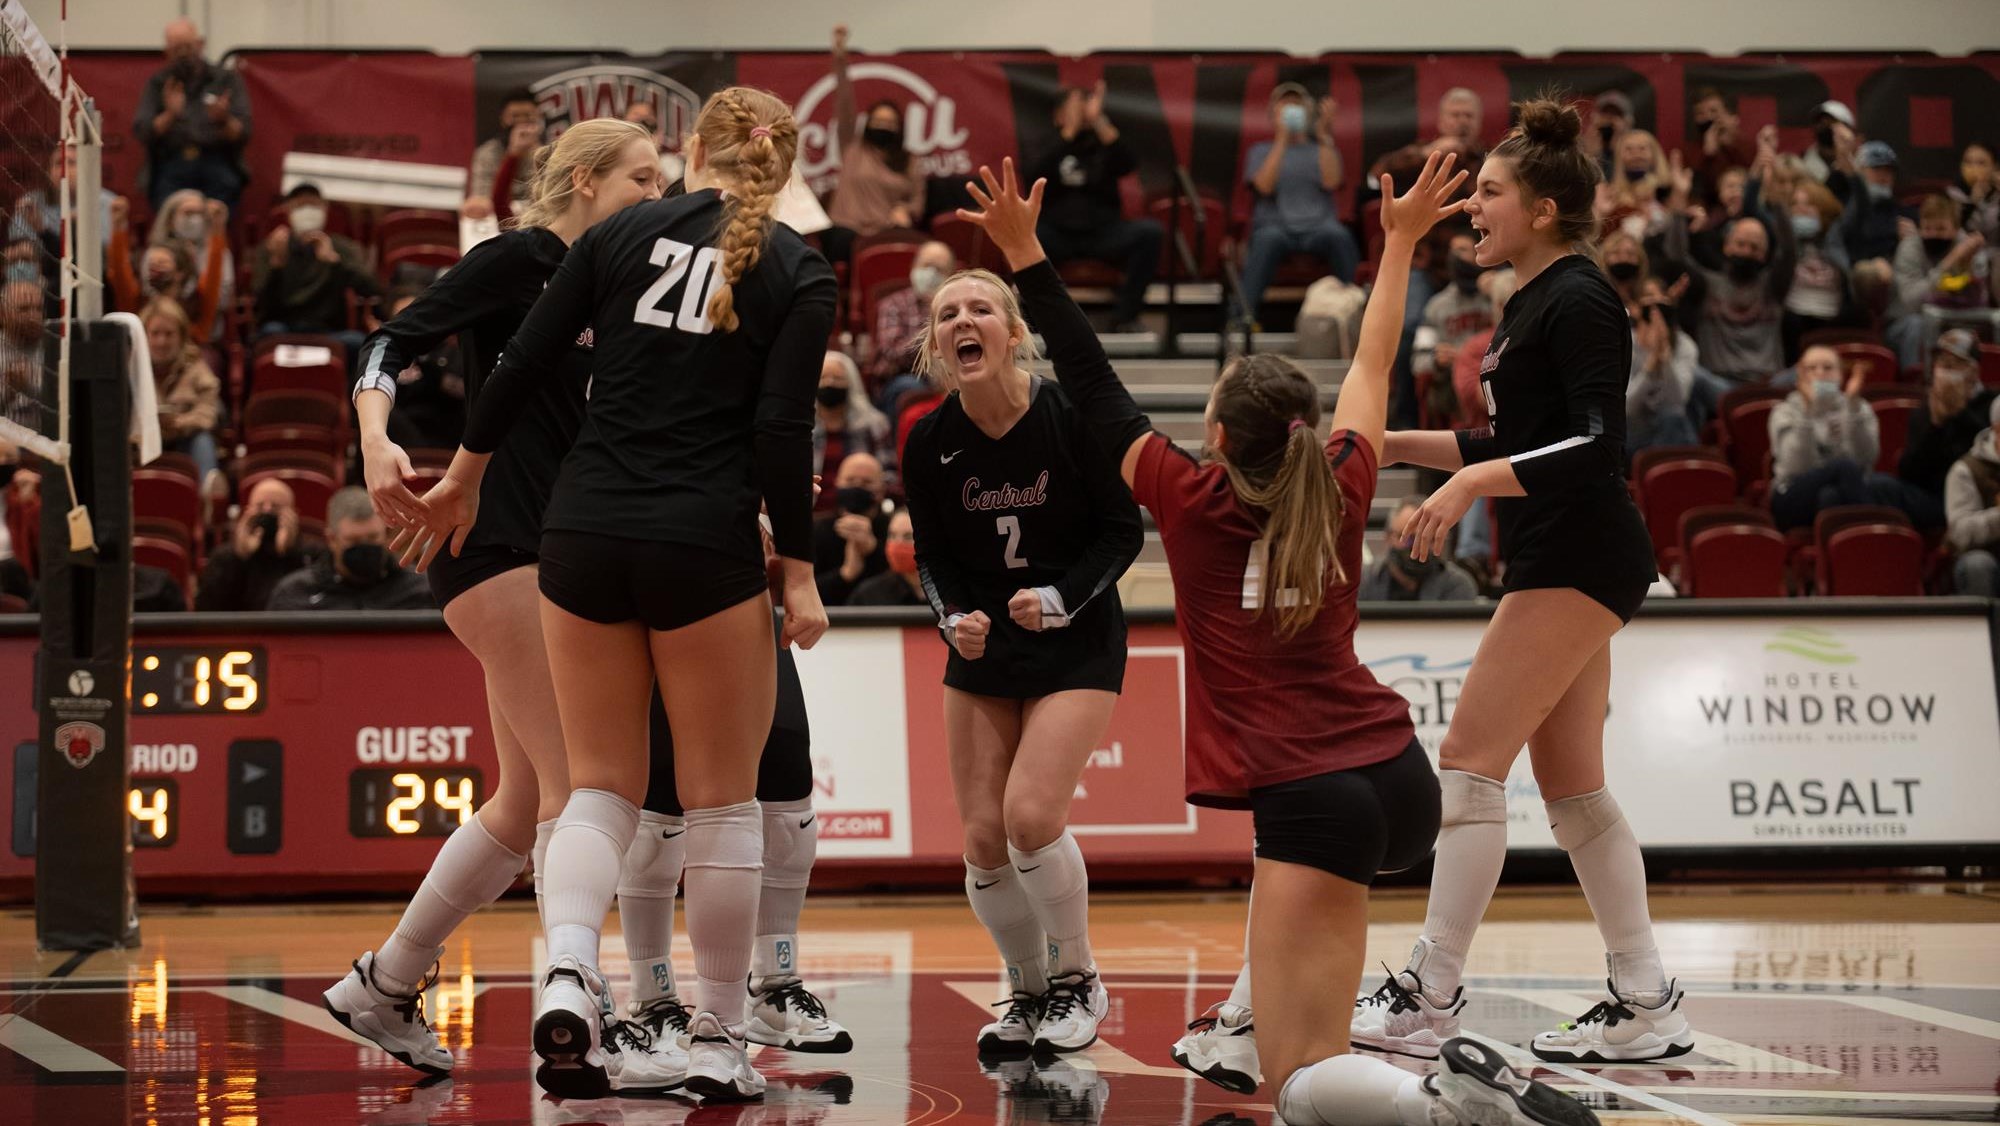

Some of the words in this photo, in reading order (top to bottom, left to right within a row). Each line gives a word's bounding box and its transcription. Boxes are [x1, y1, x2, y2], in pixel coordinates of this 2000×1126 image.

[633, 237, 728, 335] 20
[962, 470, 1048, 511] Central
[996, 515, 1029, 569] 2
[1764, 672, 1860, 689] HOTEL
[1698, 694, 1936, 725] WINDROW
[131, 743, 198, 772] RIOD
[356, 725, 473, 763] GUEST
[128, 788, 168, 840] 4
[386, 773, 474, 833] 24
[1729, 779, 1921, 817] BASALT
